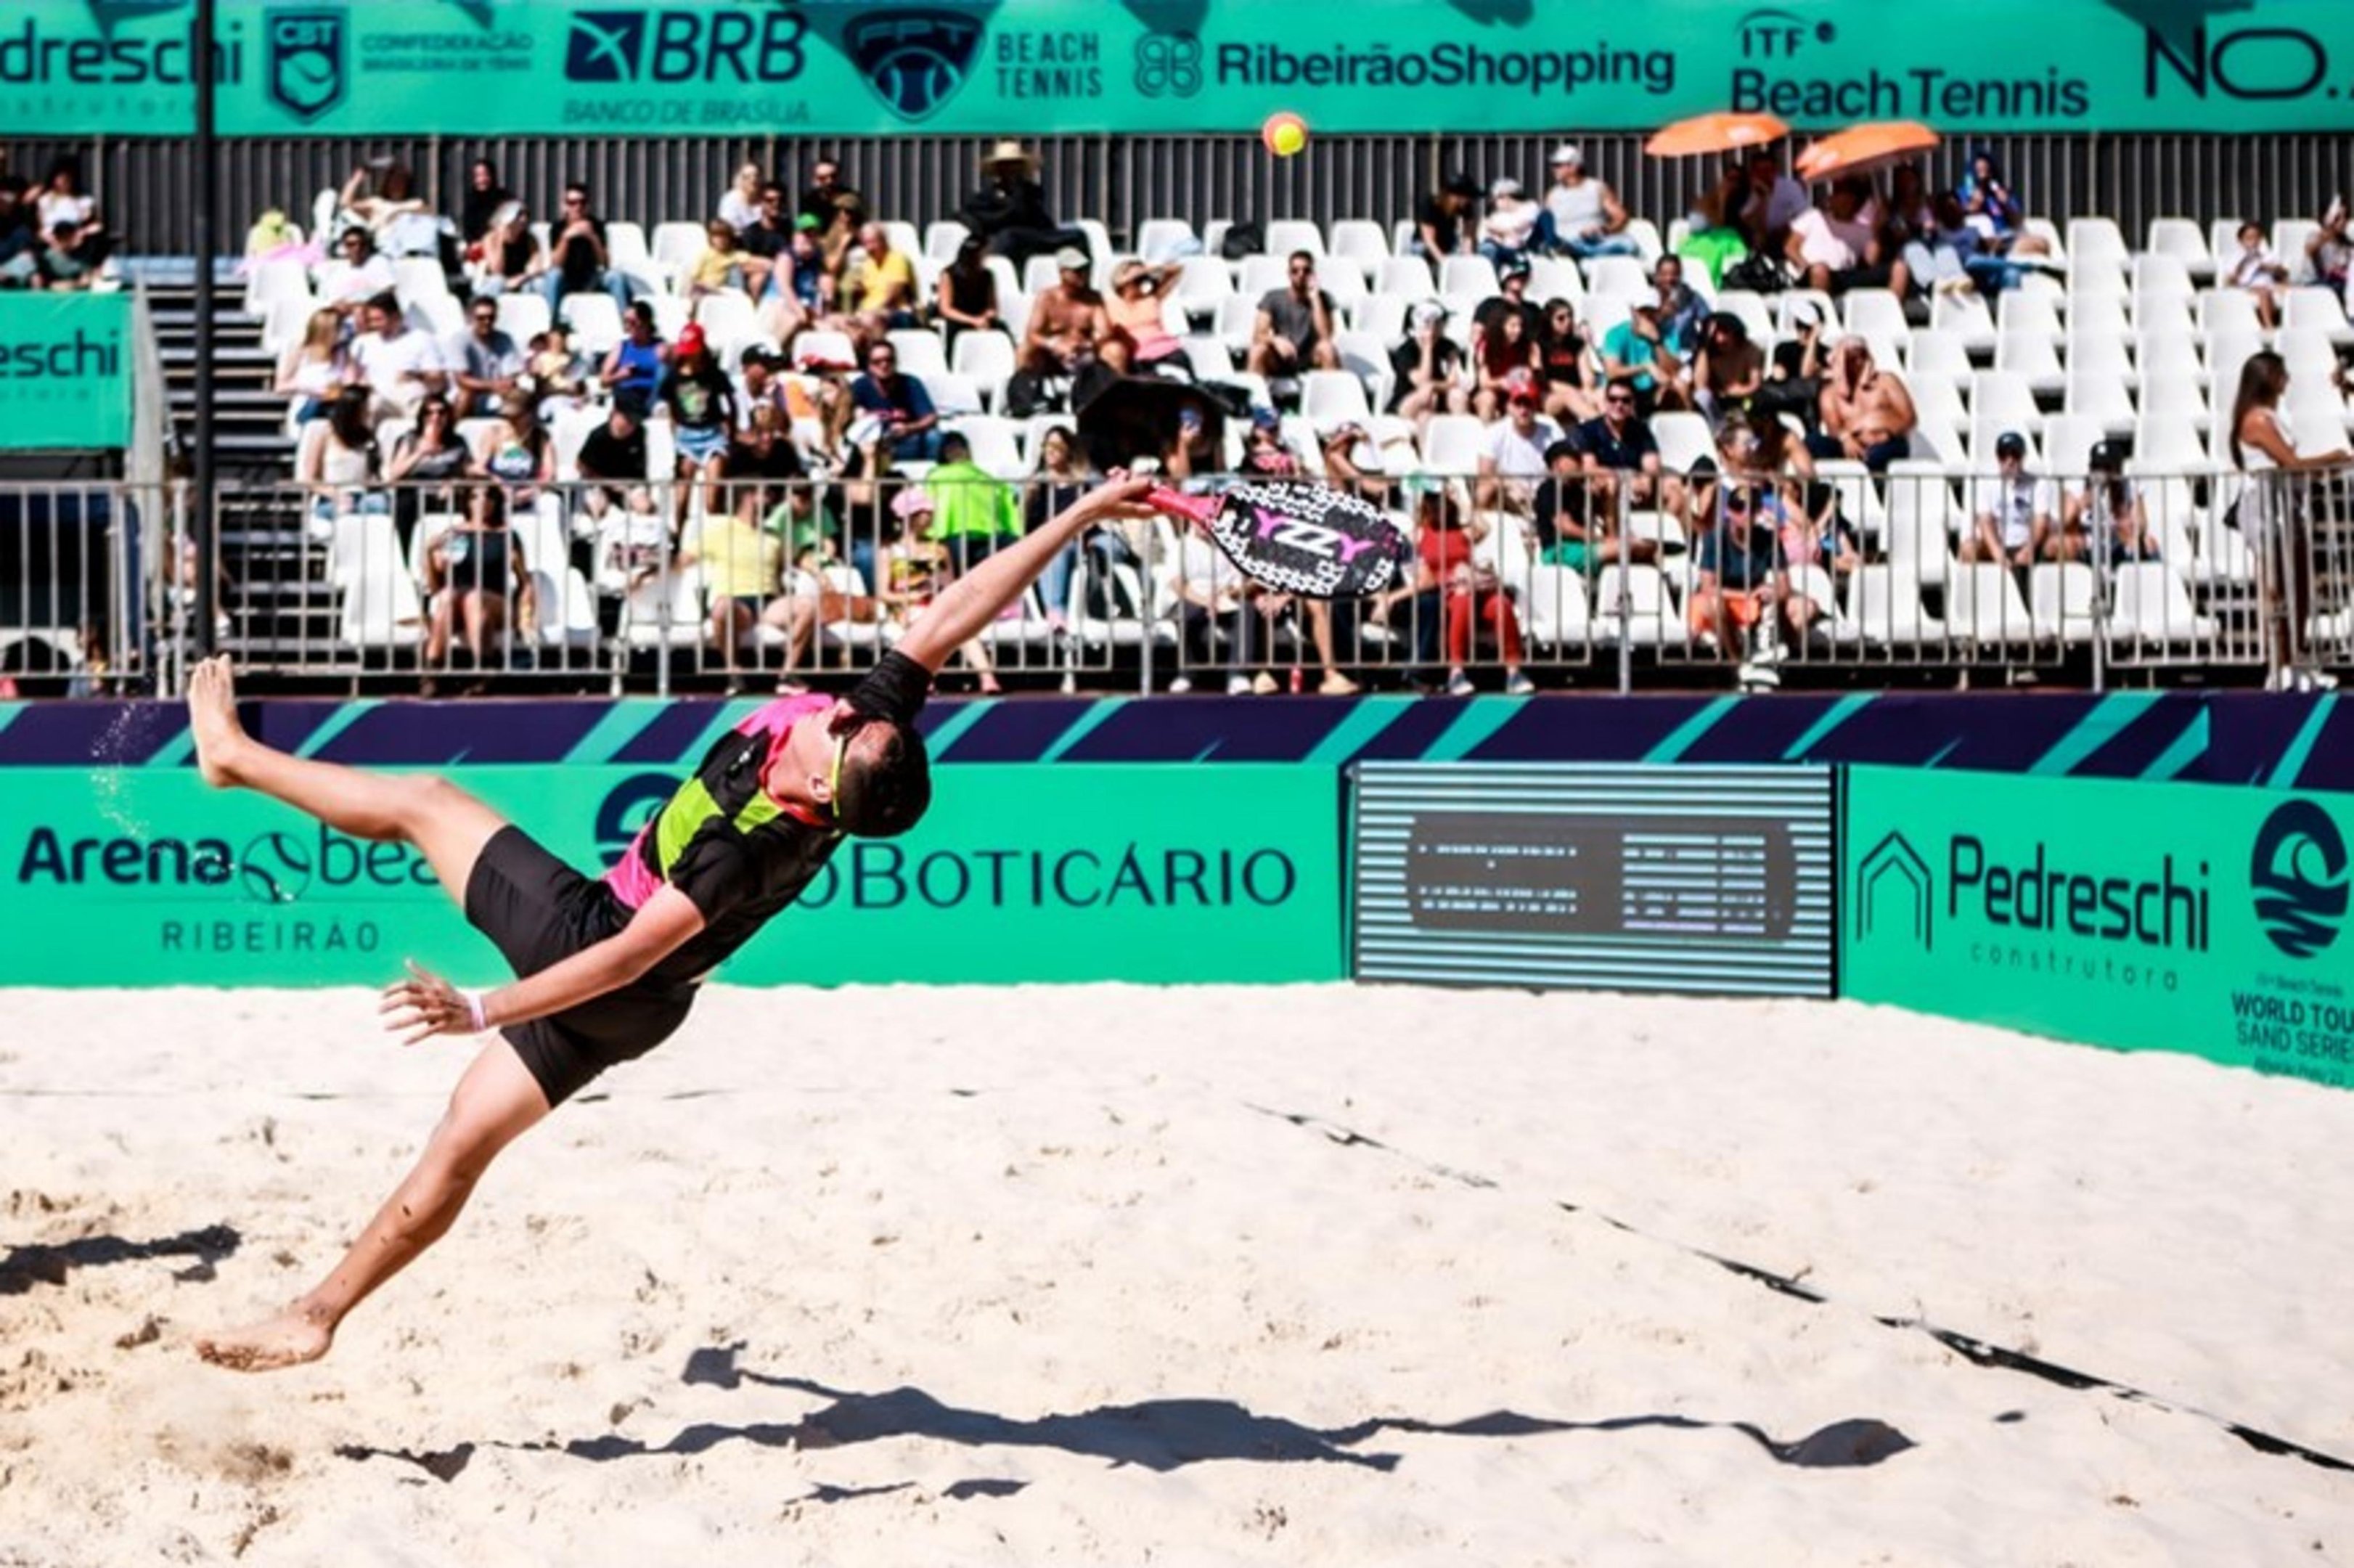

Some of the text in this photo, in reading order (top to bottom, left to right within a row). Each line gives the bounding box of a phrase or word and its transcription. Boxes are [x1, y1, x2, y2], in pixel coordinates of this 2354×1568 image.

[277, 20, 336, 46] CBT
[651, 10, 808, 83] BRB
[996, 33, 1100, 63] BEACH
[1743, 28, 1805, 58] ITF
[996, 67, 1103, 97] TENNIS
[1217, 41, 1676, 96] RibeirãoShopping
[1730, 66, 2090, 118] Beach Tennis
[563, 99, 654, 123] BANCO
[660, 99, 693, 123] DE
[18, 827, 233, 885] Arena
[1948, 834, 2209, 952] Pedreschi
[161, 917, 380, 952] RIBEIRÃO
[1971, 942, 2178, 992] construtora
[2231, 990, 2306, 1026] WORLD
[2236, 1018, 2292, 1053] SAND
